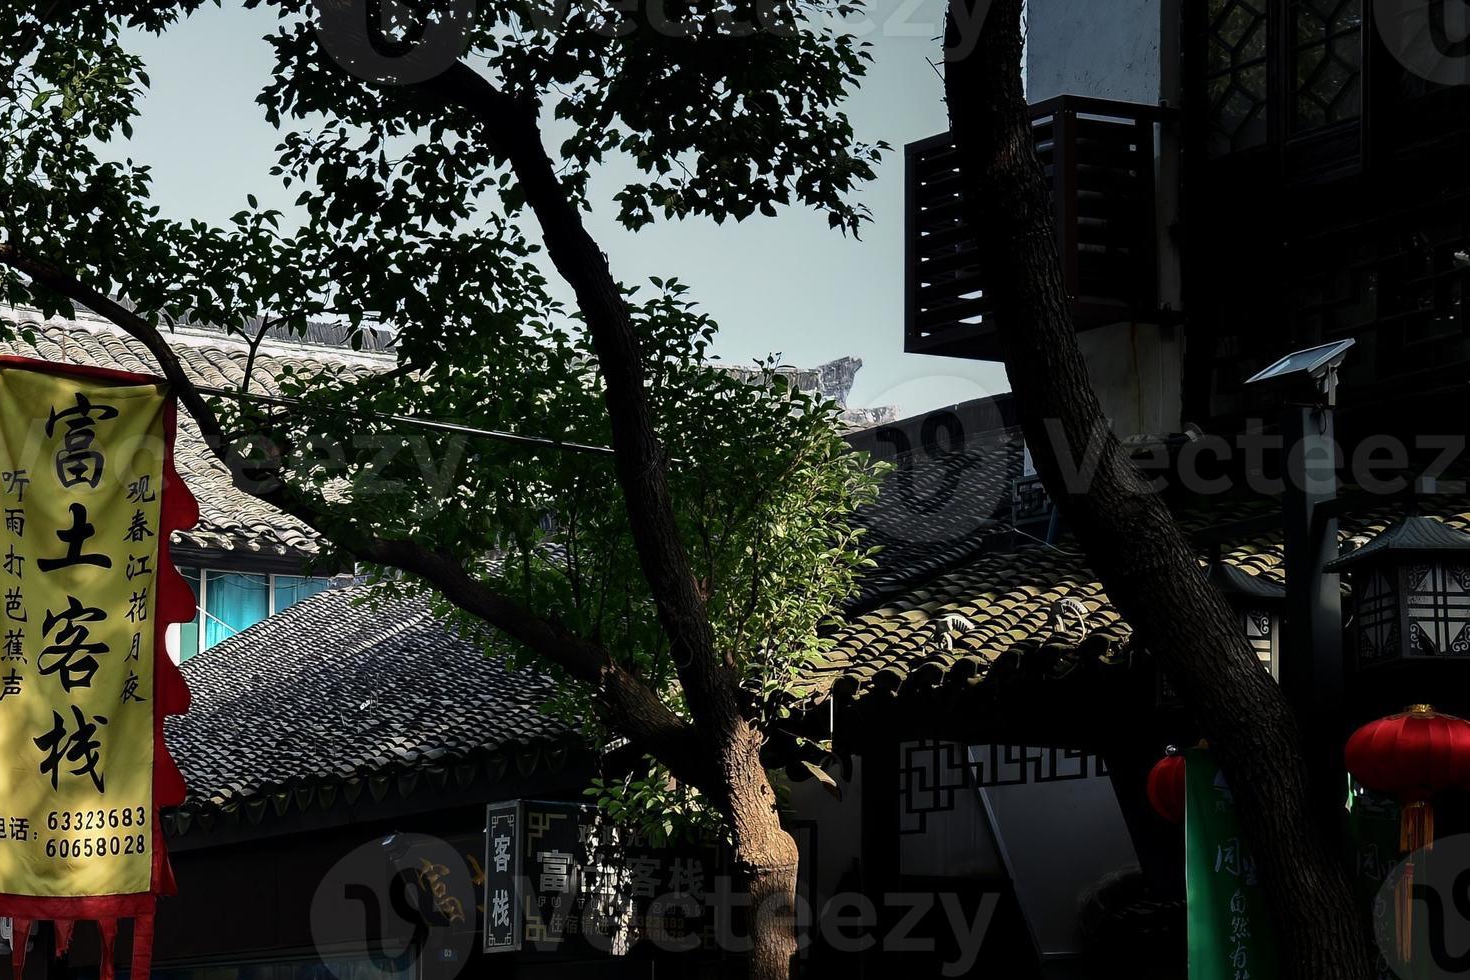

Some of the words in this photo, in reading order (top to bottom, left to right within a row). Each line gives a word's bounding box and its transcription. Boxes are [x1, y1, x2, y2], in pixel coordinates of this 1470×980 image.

[33, 392, 118, 793] 富土客栈
[120, 474, 156, 704] 观春江花月夜
[45, 835, 146, 859] 60658028
[48, 806, 146, 831] 63323683
[491, 834, 512, 927] 客栈
